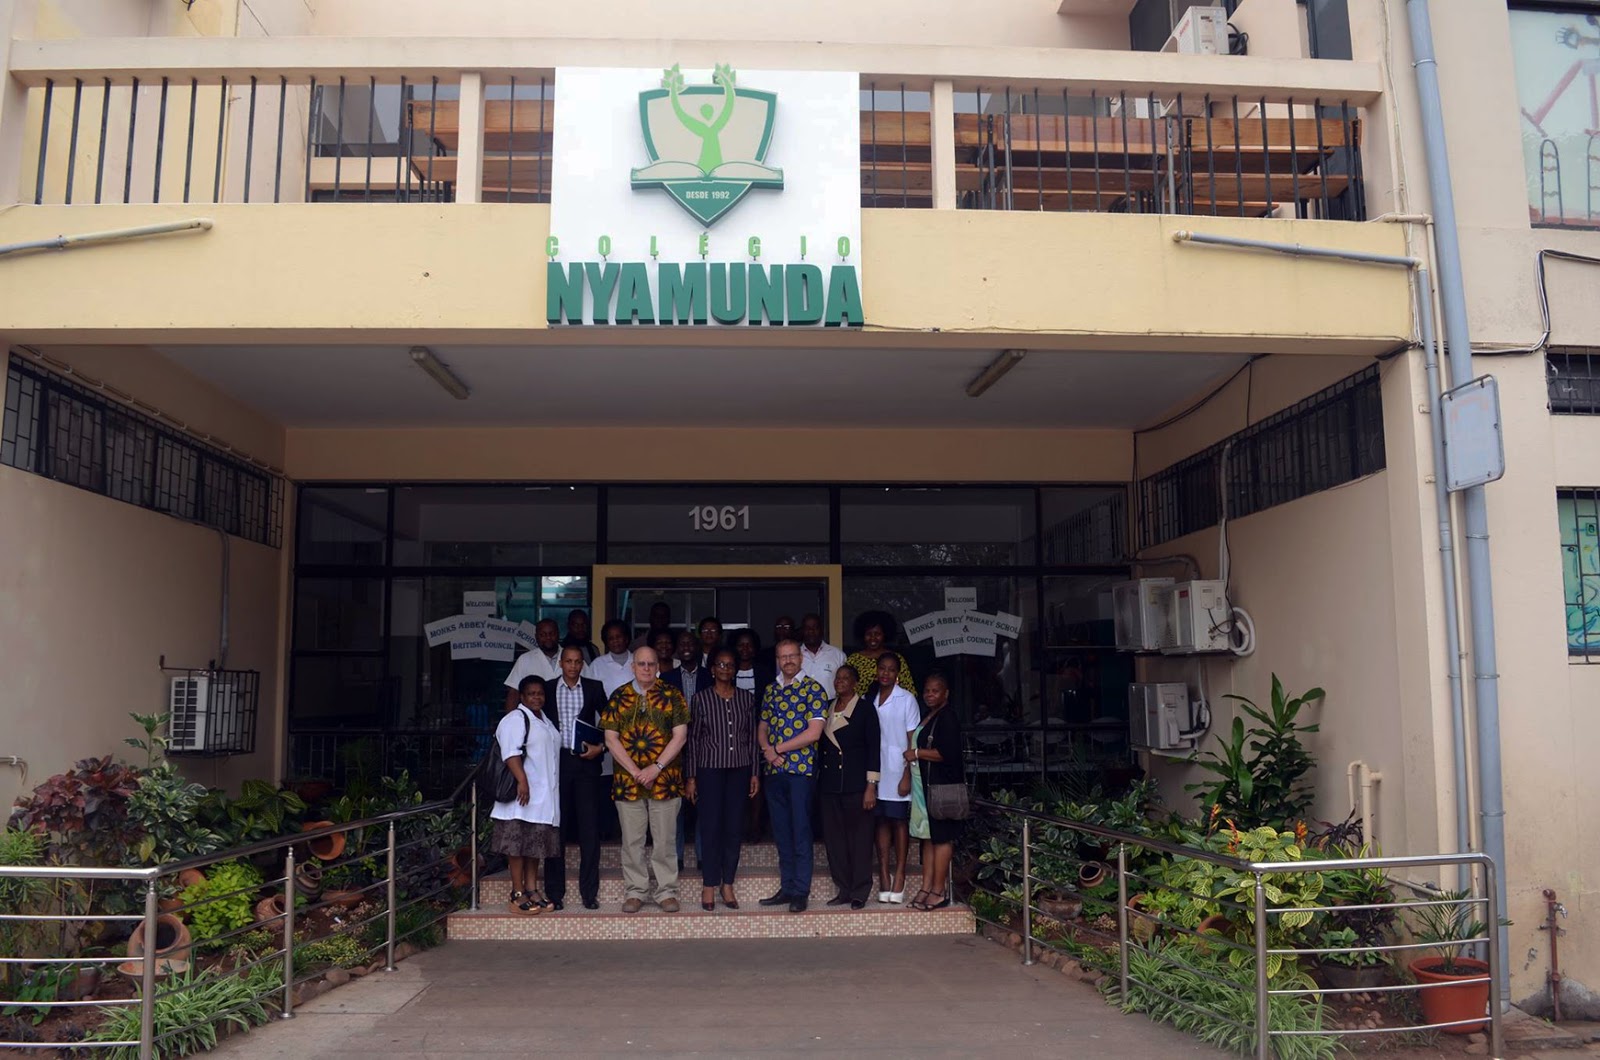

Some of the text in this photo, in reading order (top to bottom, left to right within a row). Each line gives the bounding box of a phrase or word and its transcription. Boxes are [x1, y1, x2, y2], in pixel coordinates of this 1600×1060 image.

[685, 190, 730, 199] DESDE 1992
[546, 232, 850, 257] COLÉGIO
[547, 262, 864, 327] NYAMUNDA
[688, 505, 749, 530] 1961
[430, 625, 457, 638] MONKS
[458, 620, 486, 629] ABBEY
[487, 622, 517, 634] PRIMARY
[909, 615, 1019, 635] MONKS ABBEY PRIMARY SCHOL
[962, 625, 969, 633] &
[478, 631, 486, 639] &
[935, 636, 995, 648] BRITISH COUNCIL
